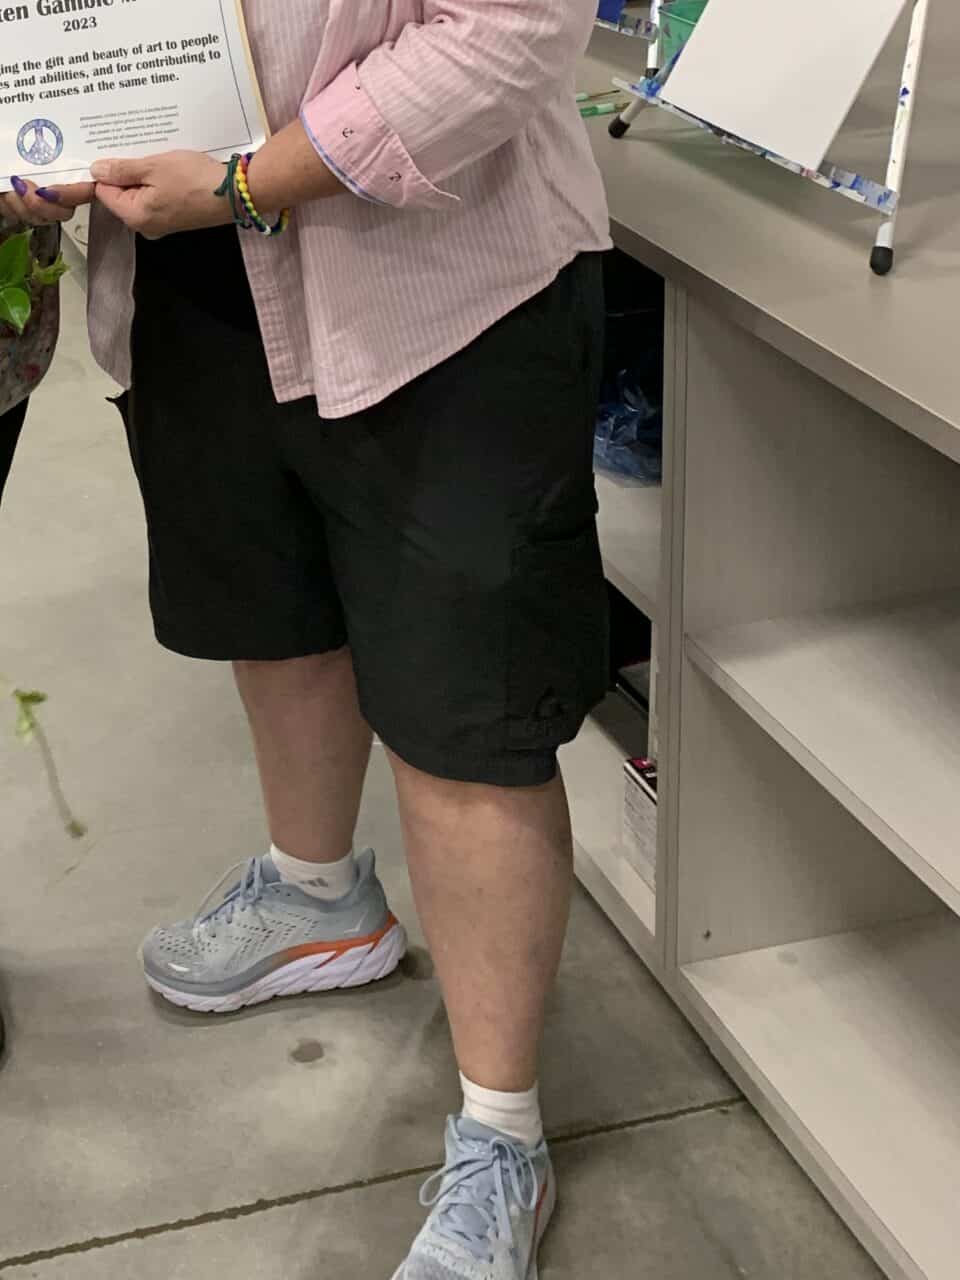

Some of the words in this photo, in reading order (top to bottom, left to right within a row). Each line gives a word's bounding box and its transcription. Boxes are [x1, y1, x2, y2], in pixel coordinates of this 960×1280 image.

[63, 17, 97, 32] 2023
[23, 60, 41, 72] the
[45, 56, 65, 71] gift
[68, 52, 89, 65] and
[92, 47, 129, 61] beauty
[132, 44, 142, 55] of
[146, 42, 163, 53] art
[165, 40, 177, 50] to
[181, 33, 219, 50] people
[14, 75, 36, 88] and
[40, 70, 89, 85] abilities,
[92, 65, 113, 77] and
[116, 61, 132, 73] for
[135, 51, 206, 70] contributing
[208, 50, 221, 60] to
[39, 85, 80, 99] causes
[83, 83, 95, 94] at
[97, 80, 116, 92] the
[118, 76, 148, 89] same
[151, 72, 179, 84] time.
